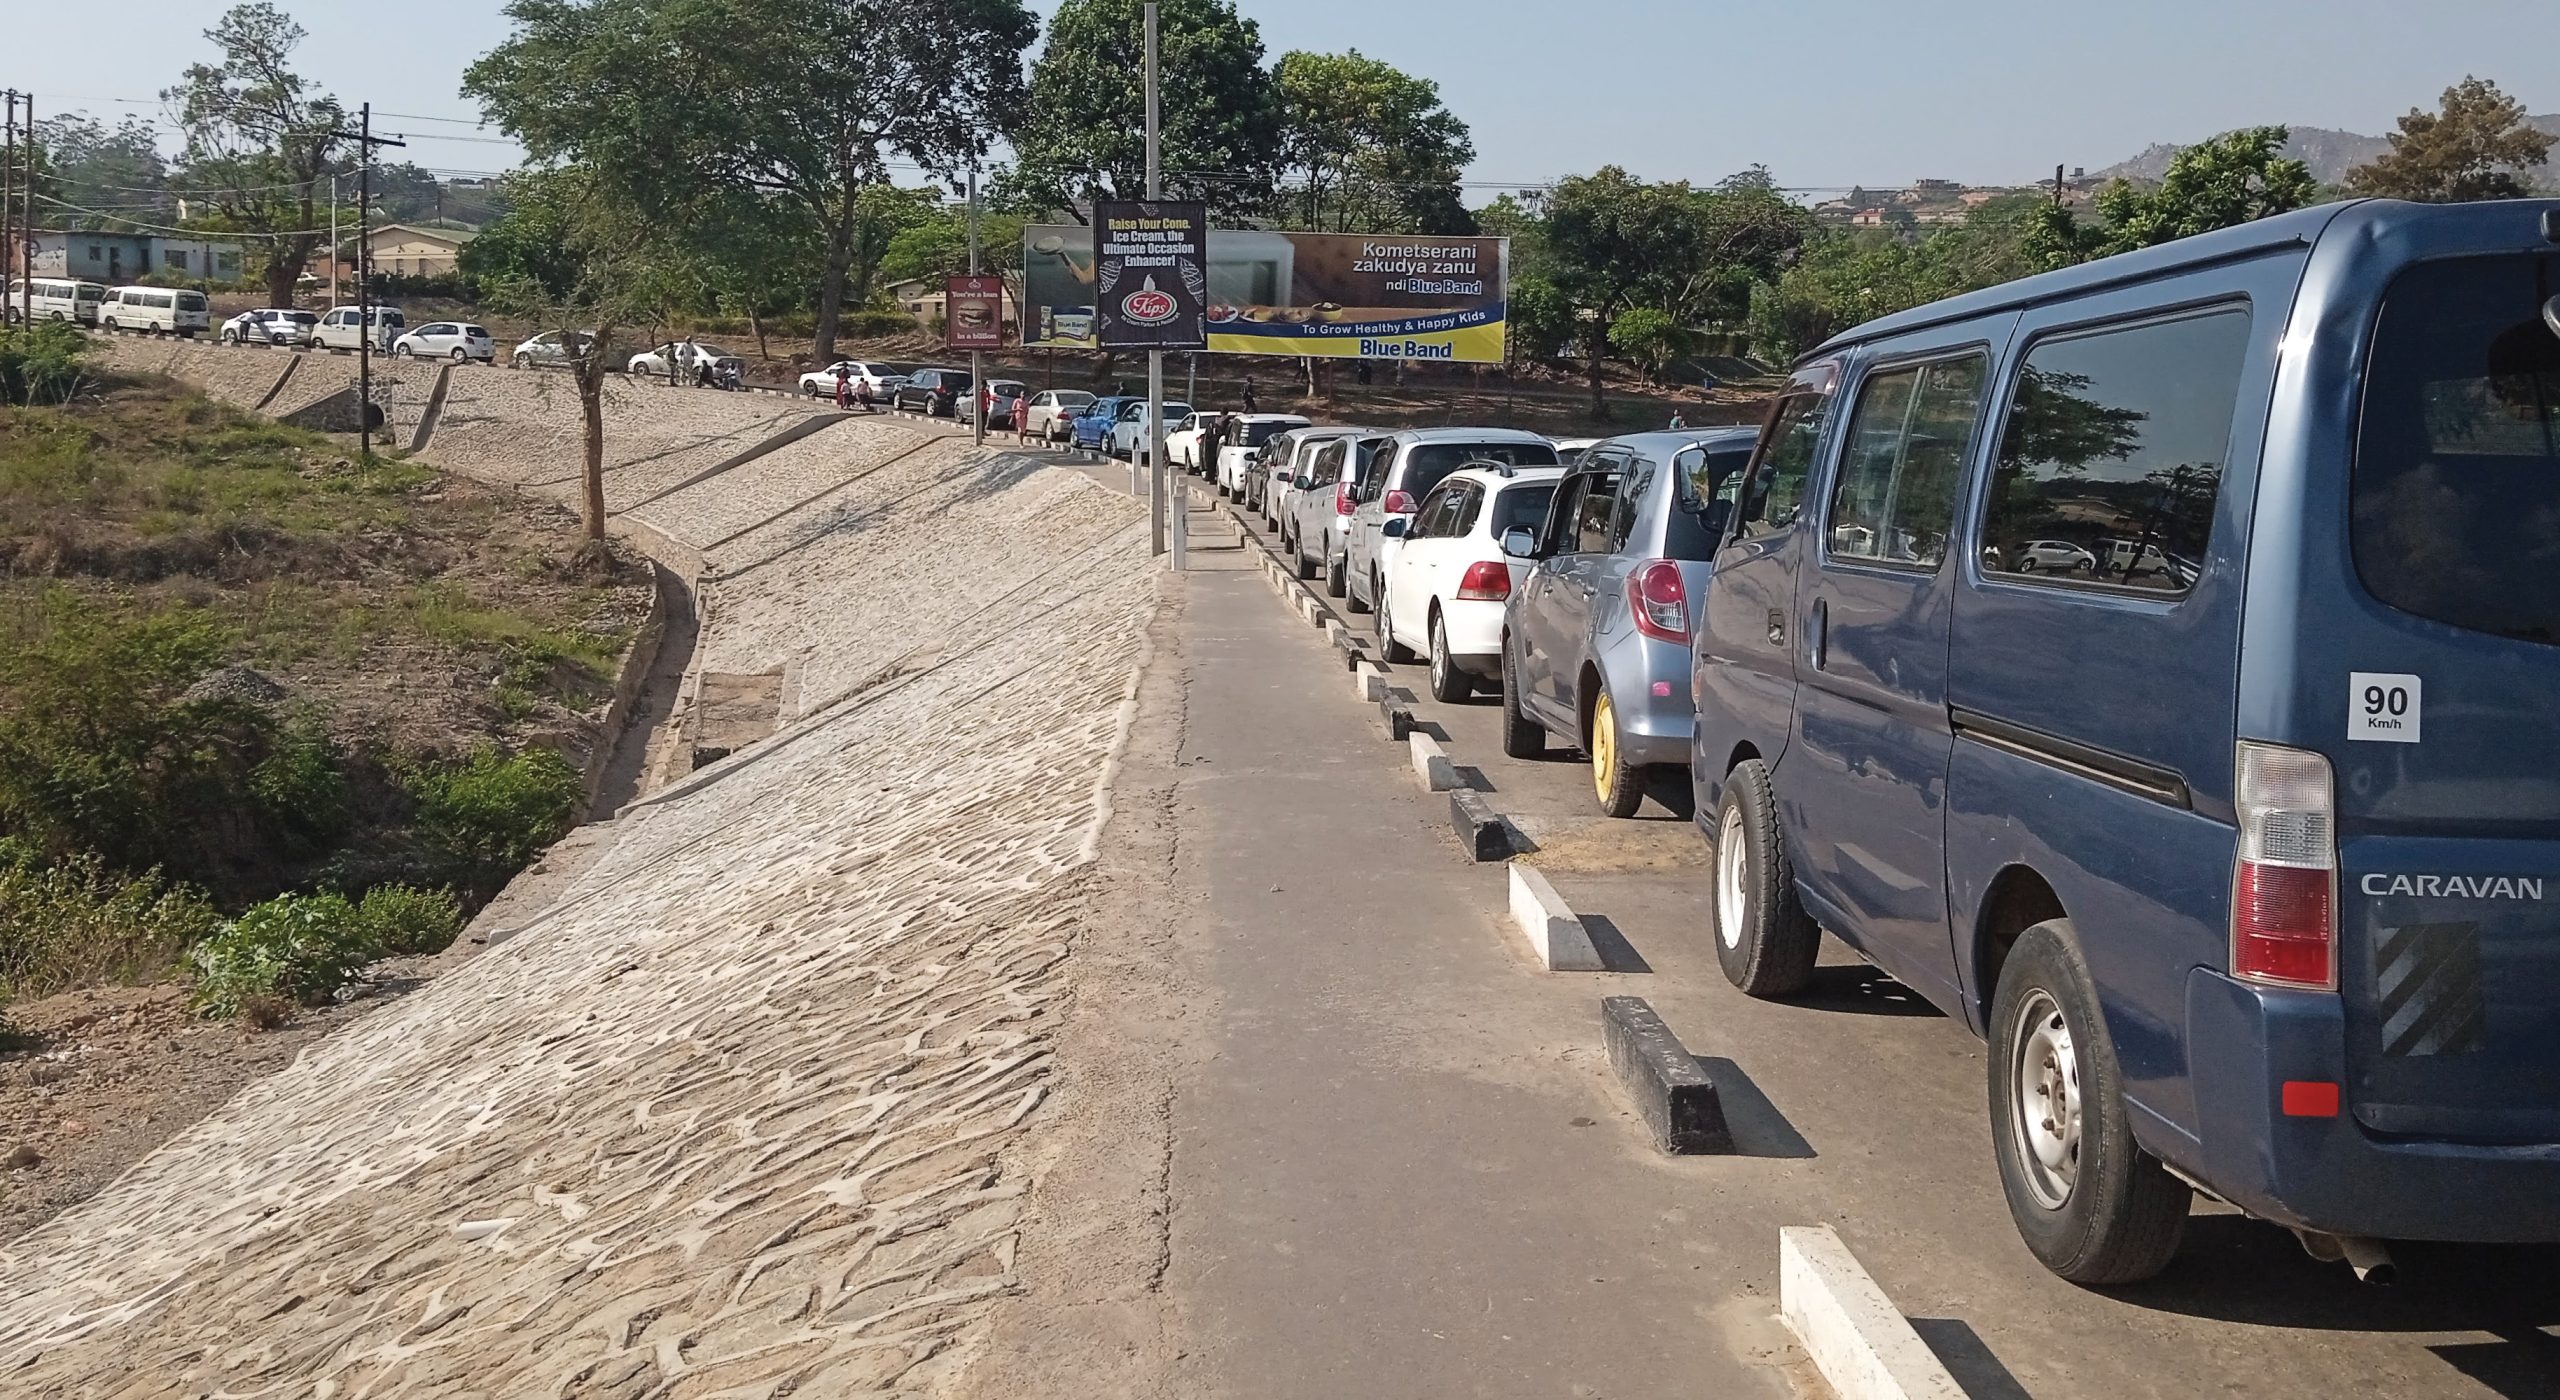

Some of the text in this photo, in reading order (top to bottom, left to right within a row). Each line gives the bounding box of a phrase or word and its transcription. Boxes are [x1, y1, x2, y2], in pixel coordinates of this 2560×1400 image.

[1108, 218, 1191, 230] Raise Your Cone.
[1113, 230, 1184, 242] Ice Cream, the
[1103, 243, 1195, 254] Ultimate Occasion
[1363, 242, 1477, 259] Kometserani
[1125, 255, 1176, 267] Enhancer!
[1353, 258, 1476, 275] zakudya zanu
[1386, 279, 1482, 295] ndi Blue Band
[1132, 296, 1167, 317] Kips
[1303, 311, 1486, 334] To Grow Healthy & Happy Kids
[1360, 339, 1453, 359] Blue Band
[2364, 686, 2408, 716] 90
[2368, 718, 2402, 729] Km/h
[2361, 873, 2542, 900] CARAVAN
